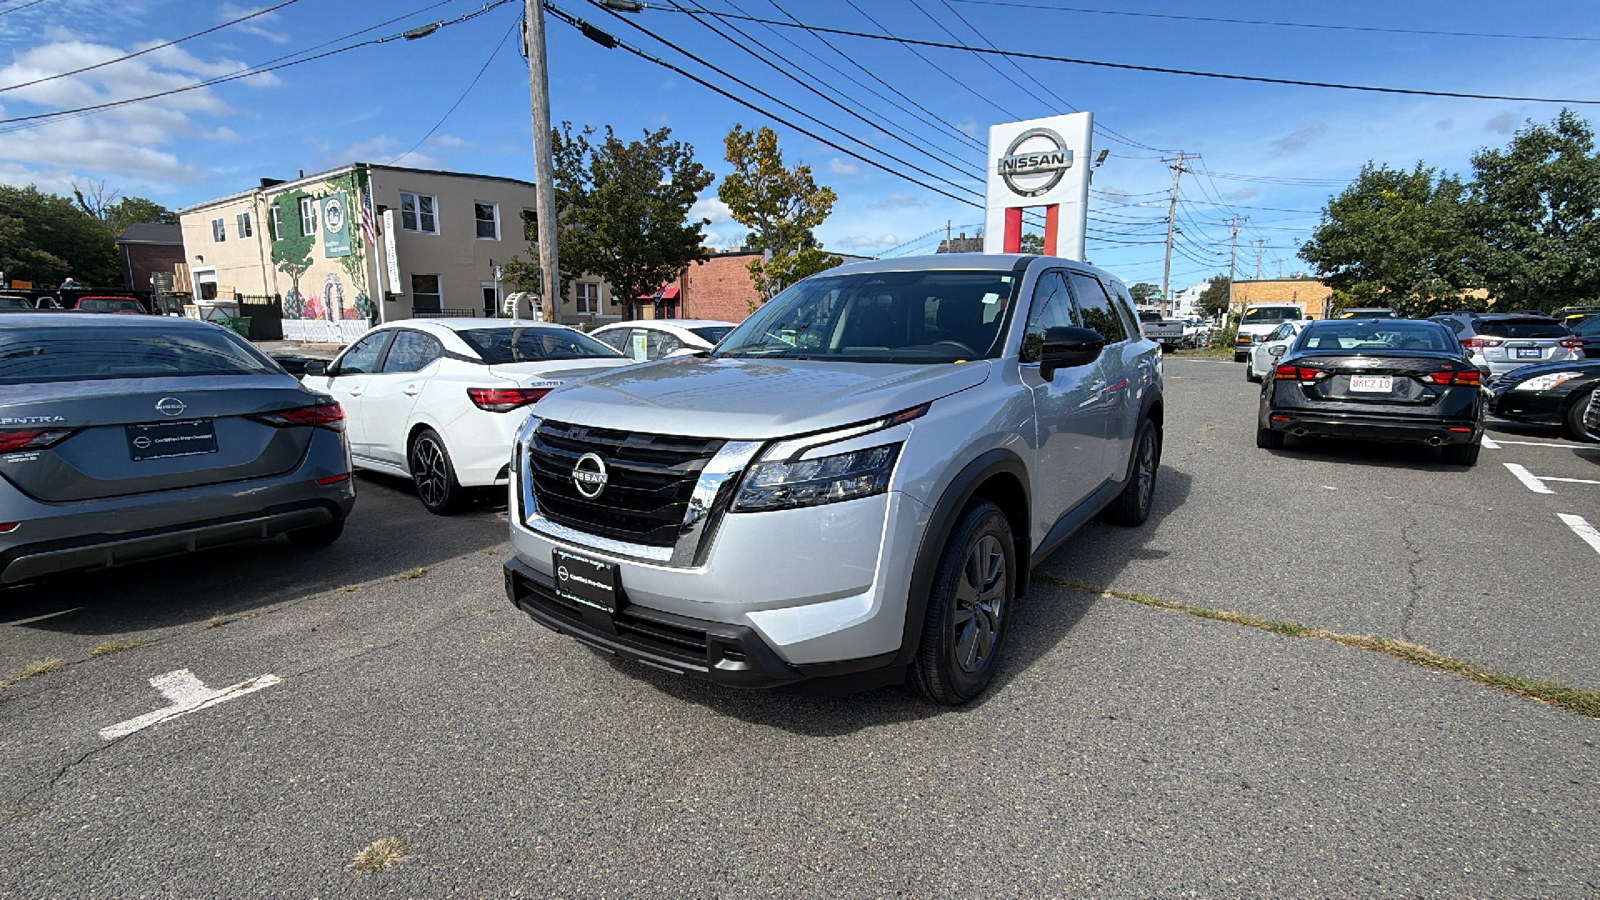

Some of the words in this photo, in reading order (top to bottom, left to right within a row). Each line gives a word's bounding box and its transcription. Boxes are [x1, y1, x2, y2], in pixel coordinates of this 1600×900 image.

[1002, 153, 1065, 171] NISSAN
[0, 415, 66, 424] ENTRA
[572, 468, 608, 484] NISSAN
